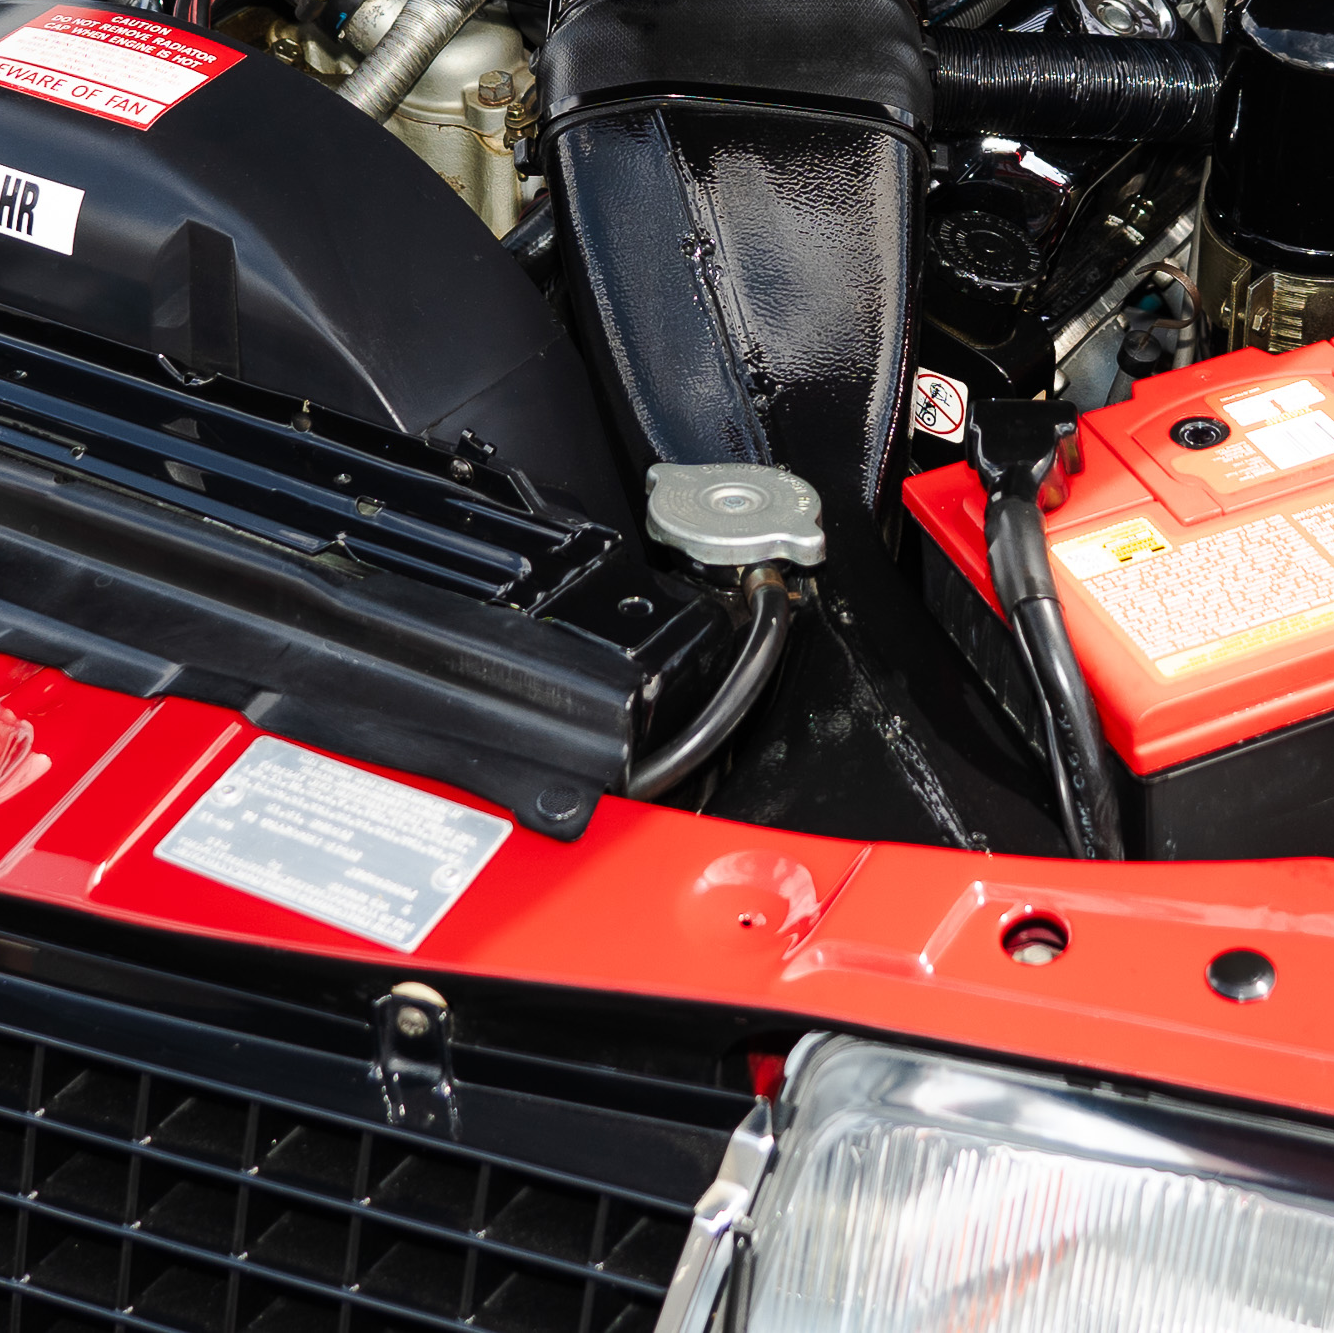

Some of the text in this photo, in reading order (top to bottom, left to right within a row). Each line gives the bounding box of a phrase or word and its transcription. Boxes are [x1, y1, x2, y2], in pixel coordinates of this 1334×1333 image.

[44, 21, 204, 70] CAP WHEN ENGINE IS HOT
[51, 14, 217, 64] DO NOT REMOVE RADIATOR
[111, 16, 172, 36] CAUTION
[71, 85, 103, 101] OF
[105, 94, 149, 116] FAN
